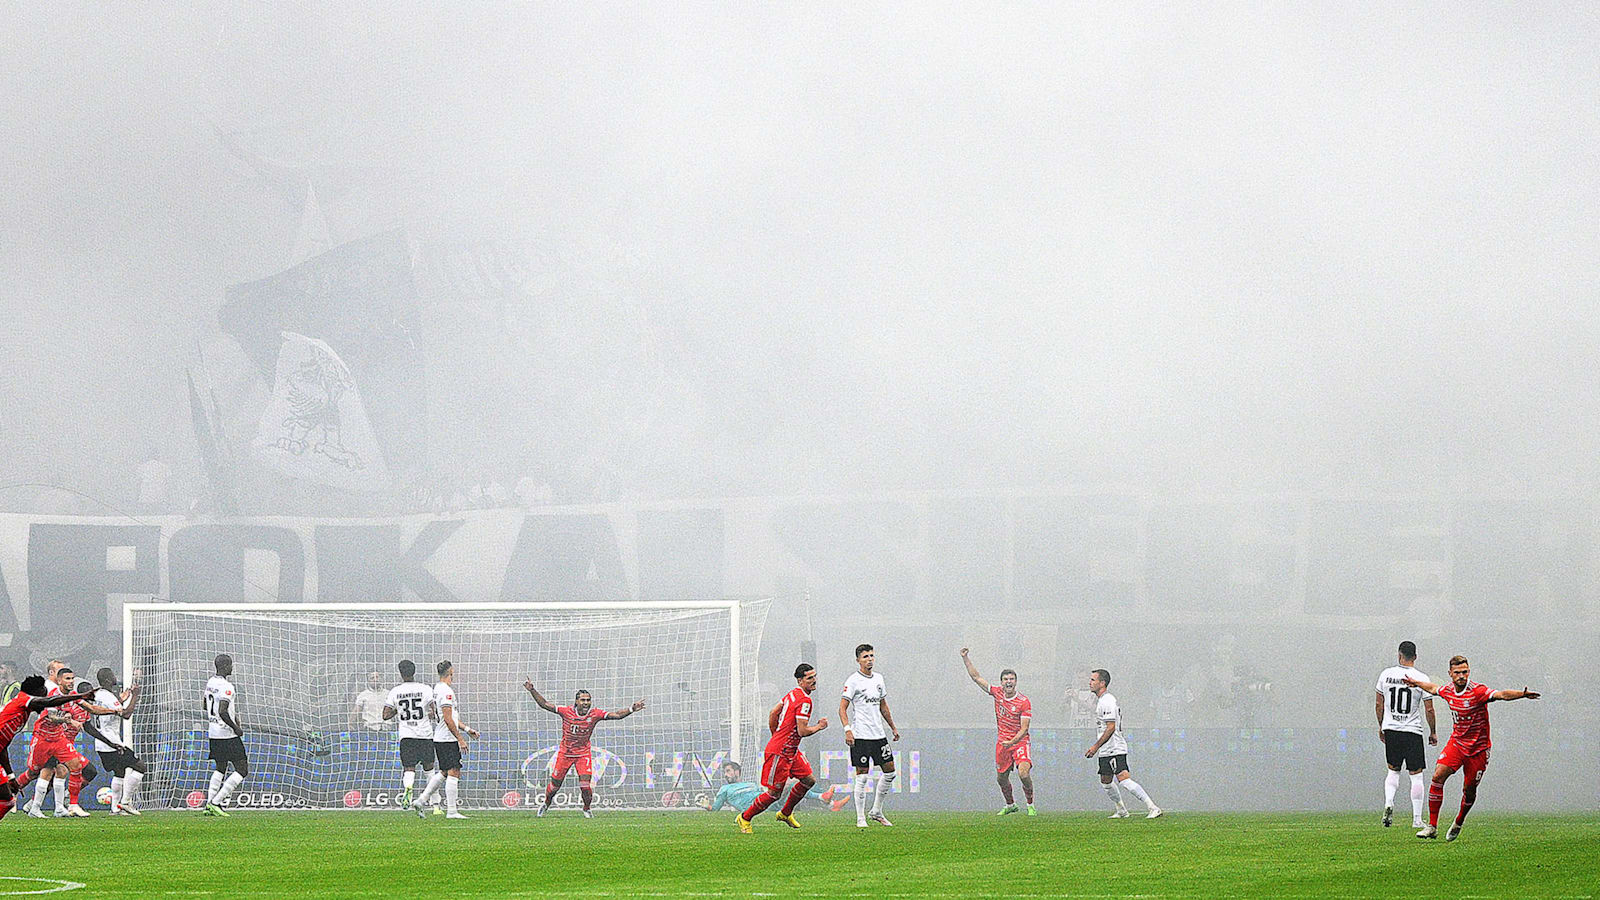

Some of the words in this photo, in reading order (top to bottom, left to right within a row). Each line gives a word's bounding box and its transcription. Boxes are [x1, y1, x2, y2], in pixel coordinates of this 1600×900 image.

[1389, 686, 1412, 714] 10
[398, 698, 424, 721] 35
[584, 757, 590, 766] 7
[236, 793, 284, 806] OLED
[365, 793, 388, 806] LG
[525, 793, 546, 806] LG
[602, 798, 623, 806] evo
